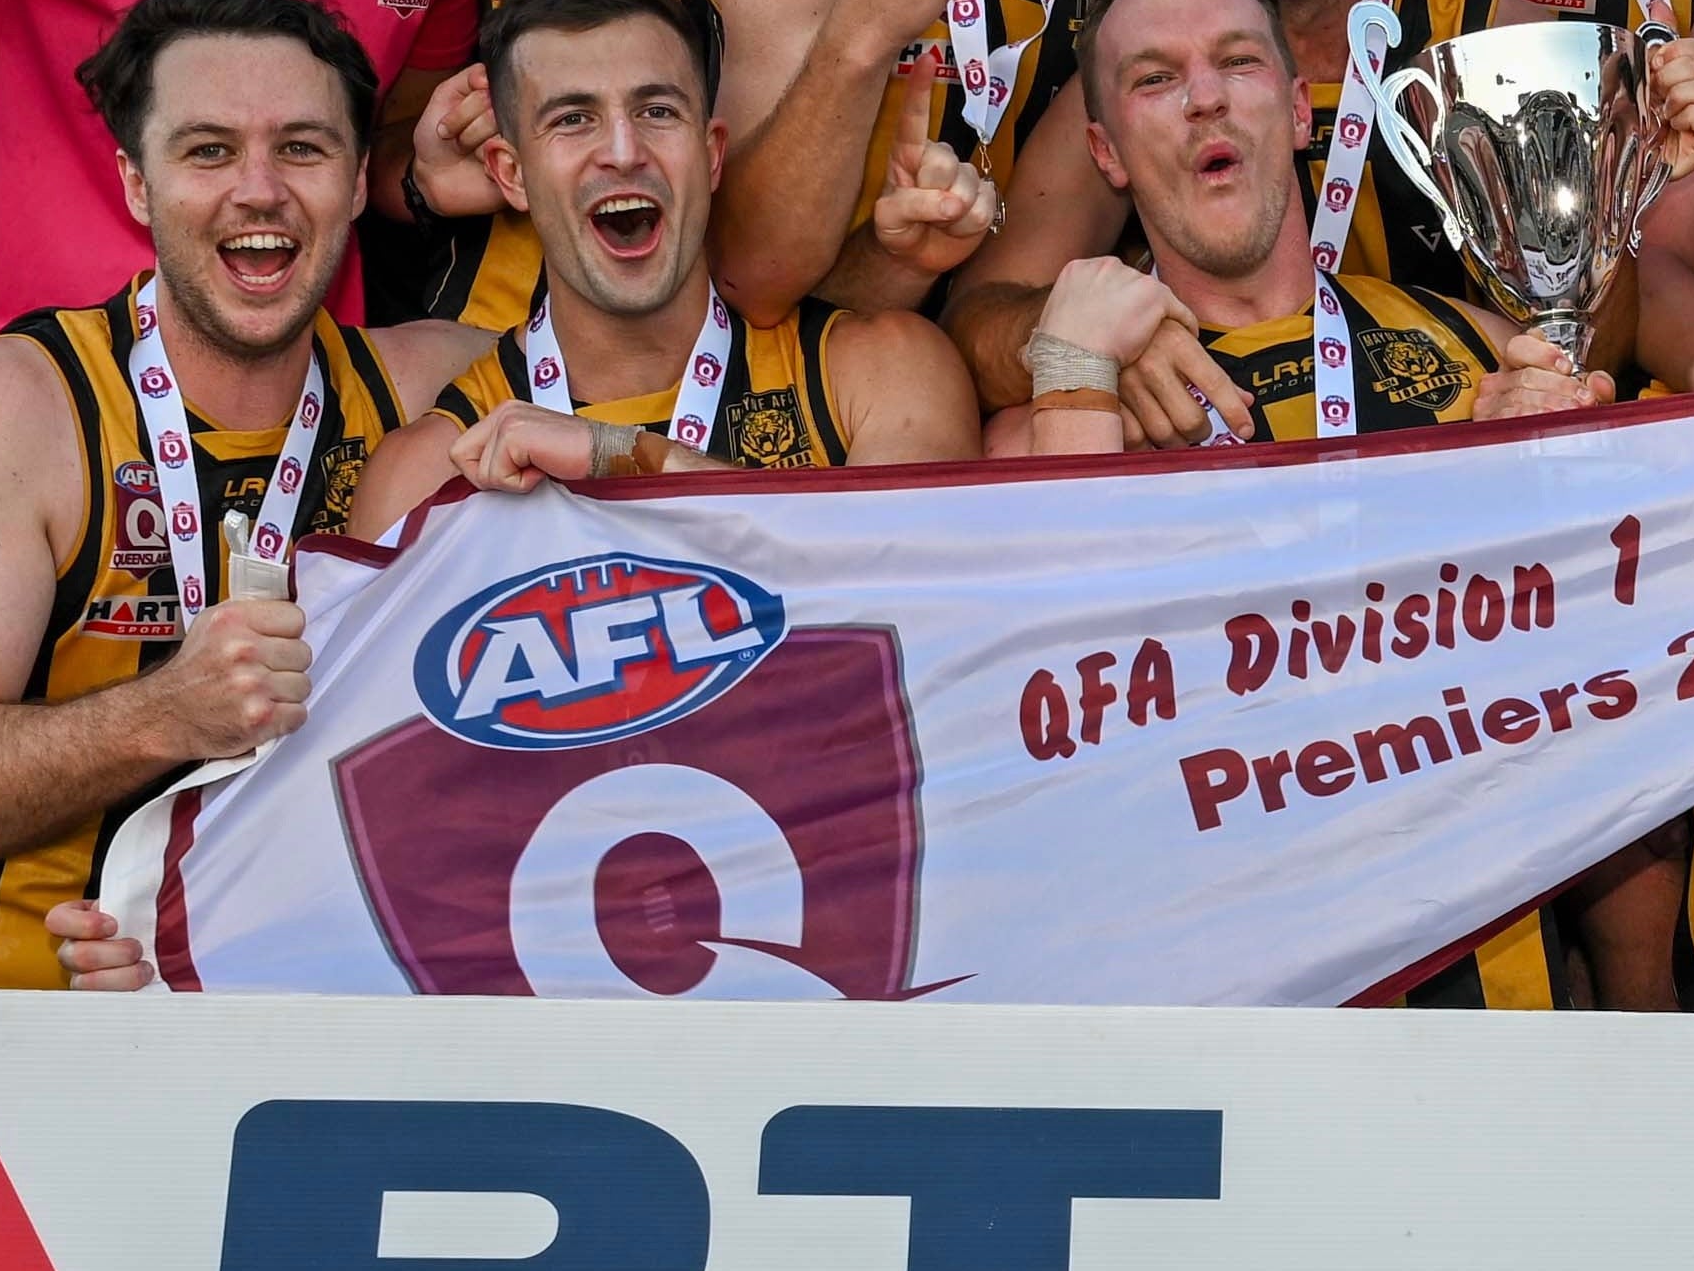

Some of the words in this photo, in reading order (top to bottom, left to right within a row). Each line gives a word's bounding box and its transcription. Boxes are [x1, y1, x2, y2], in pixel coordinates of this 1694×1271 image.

[1363, 331, 1400, 347] MAYNE
[126, 497, 166, 548] Q
[117, 625, 171, 634] SPORT
[455, 584, 762, 721] AFL
[1018, 638, 1175, 762] QFA
[1226, 562, 1556, 696] Division
[1610, 515, 1640, 606] 1
[1180, 665, 1637, 831] Premiers
[510, 764, 841, 998] Q
